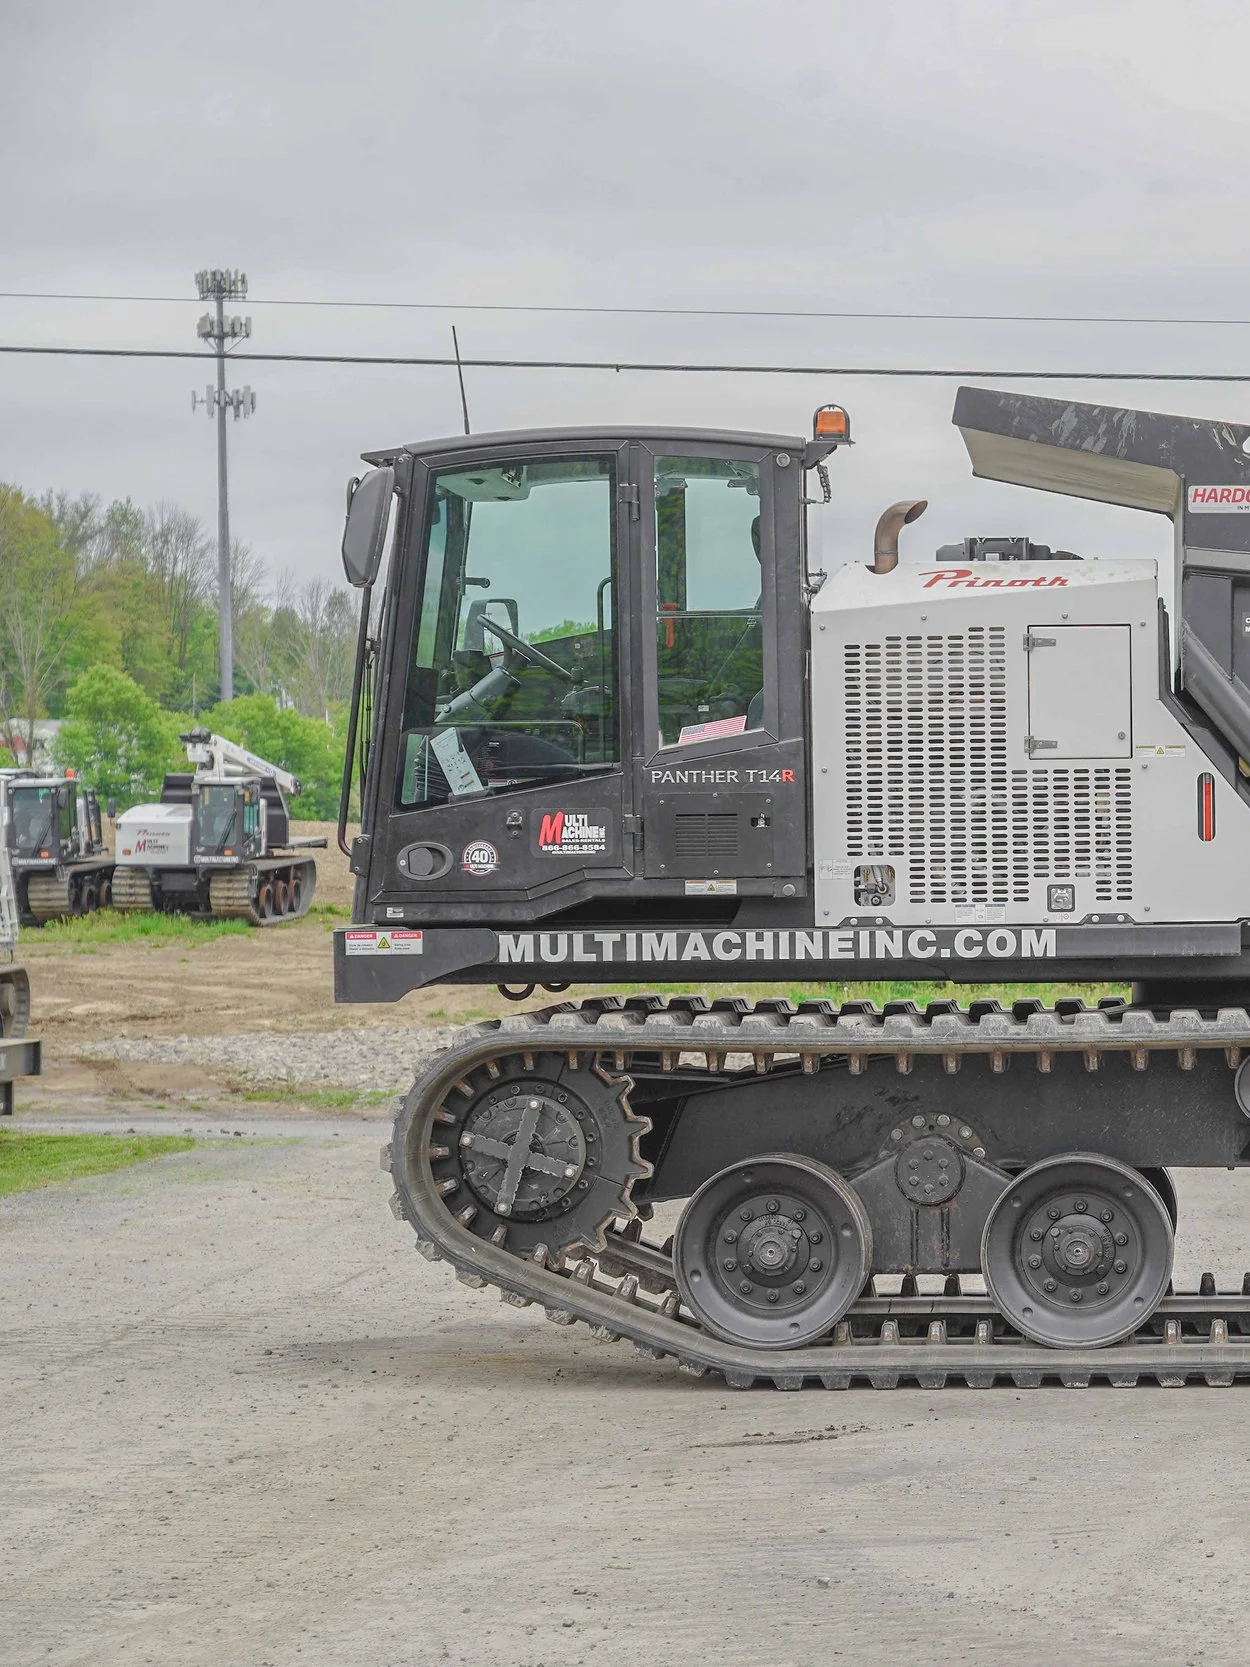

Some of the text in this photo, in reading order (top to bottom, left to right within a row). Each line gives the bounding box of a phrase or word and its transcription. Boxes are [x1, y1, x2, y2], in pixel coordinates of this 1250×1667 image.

[918, 569, 1069, 588] Prinoth
[651, 769, 796, 784] PANTHER T14R
[471, 850, 489, 863] 40
[499, 929, 1057, 963] MULTIMACHINEINC.COM
